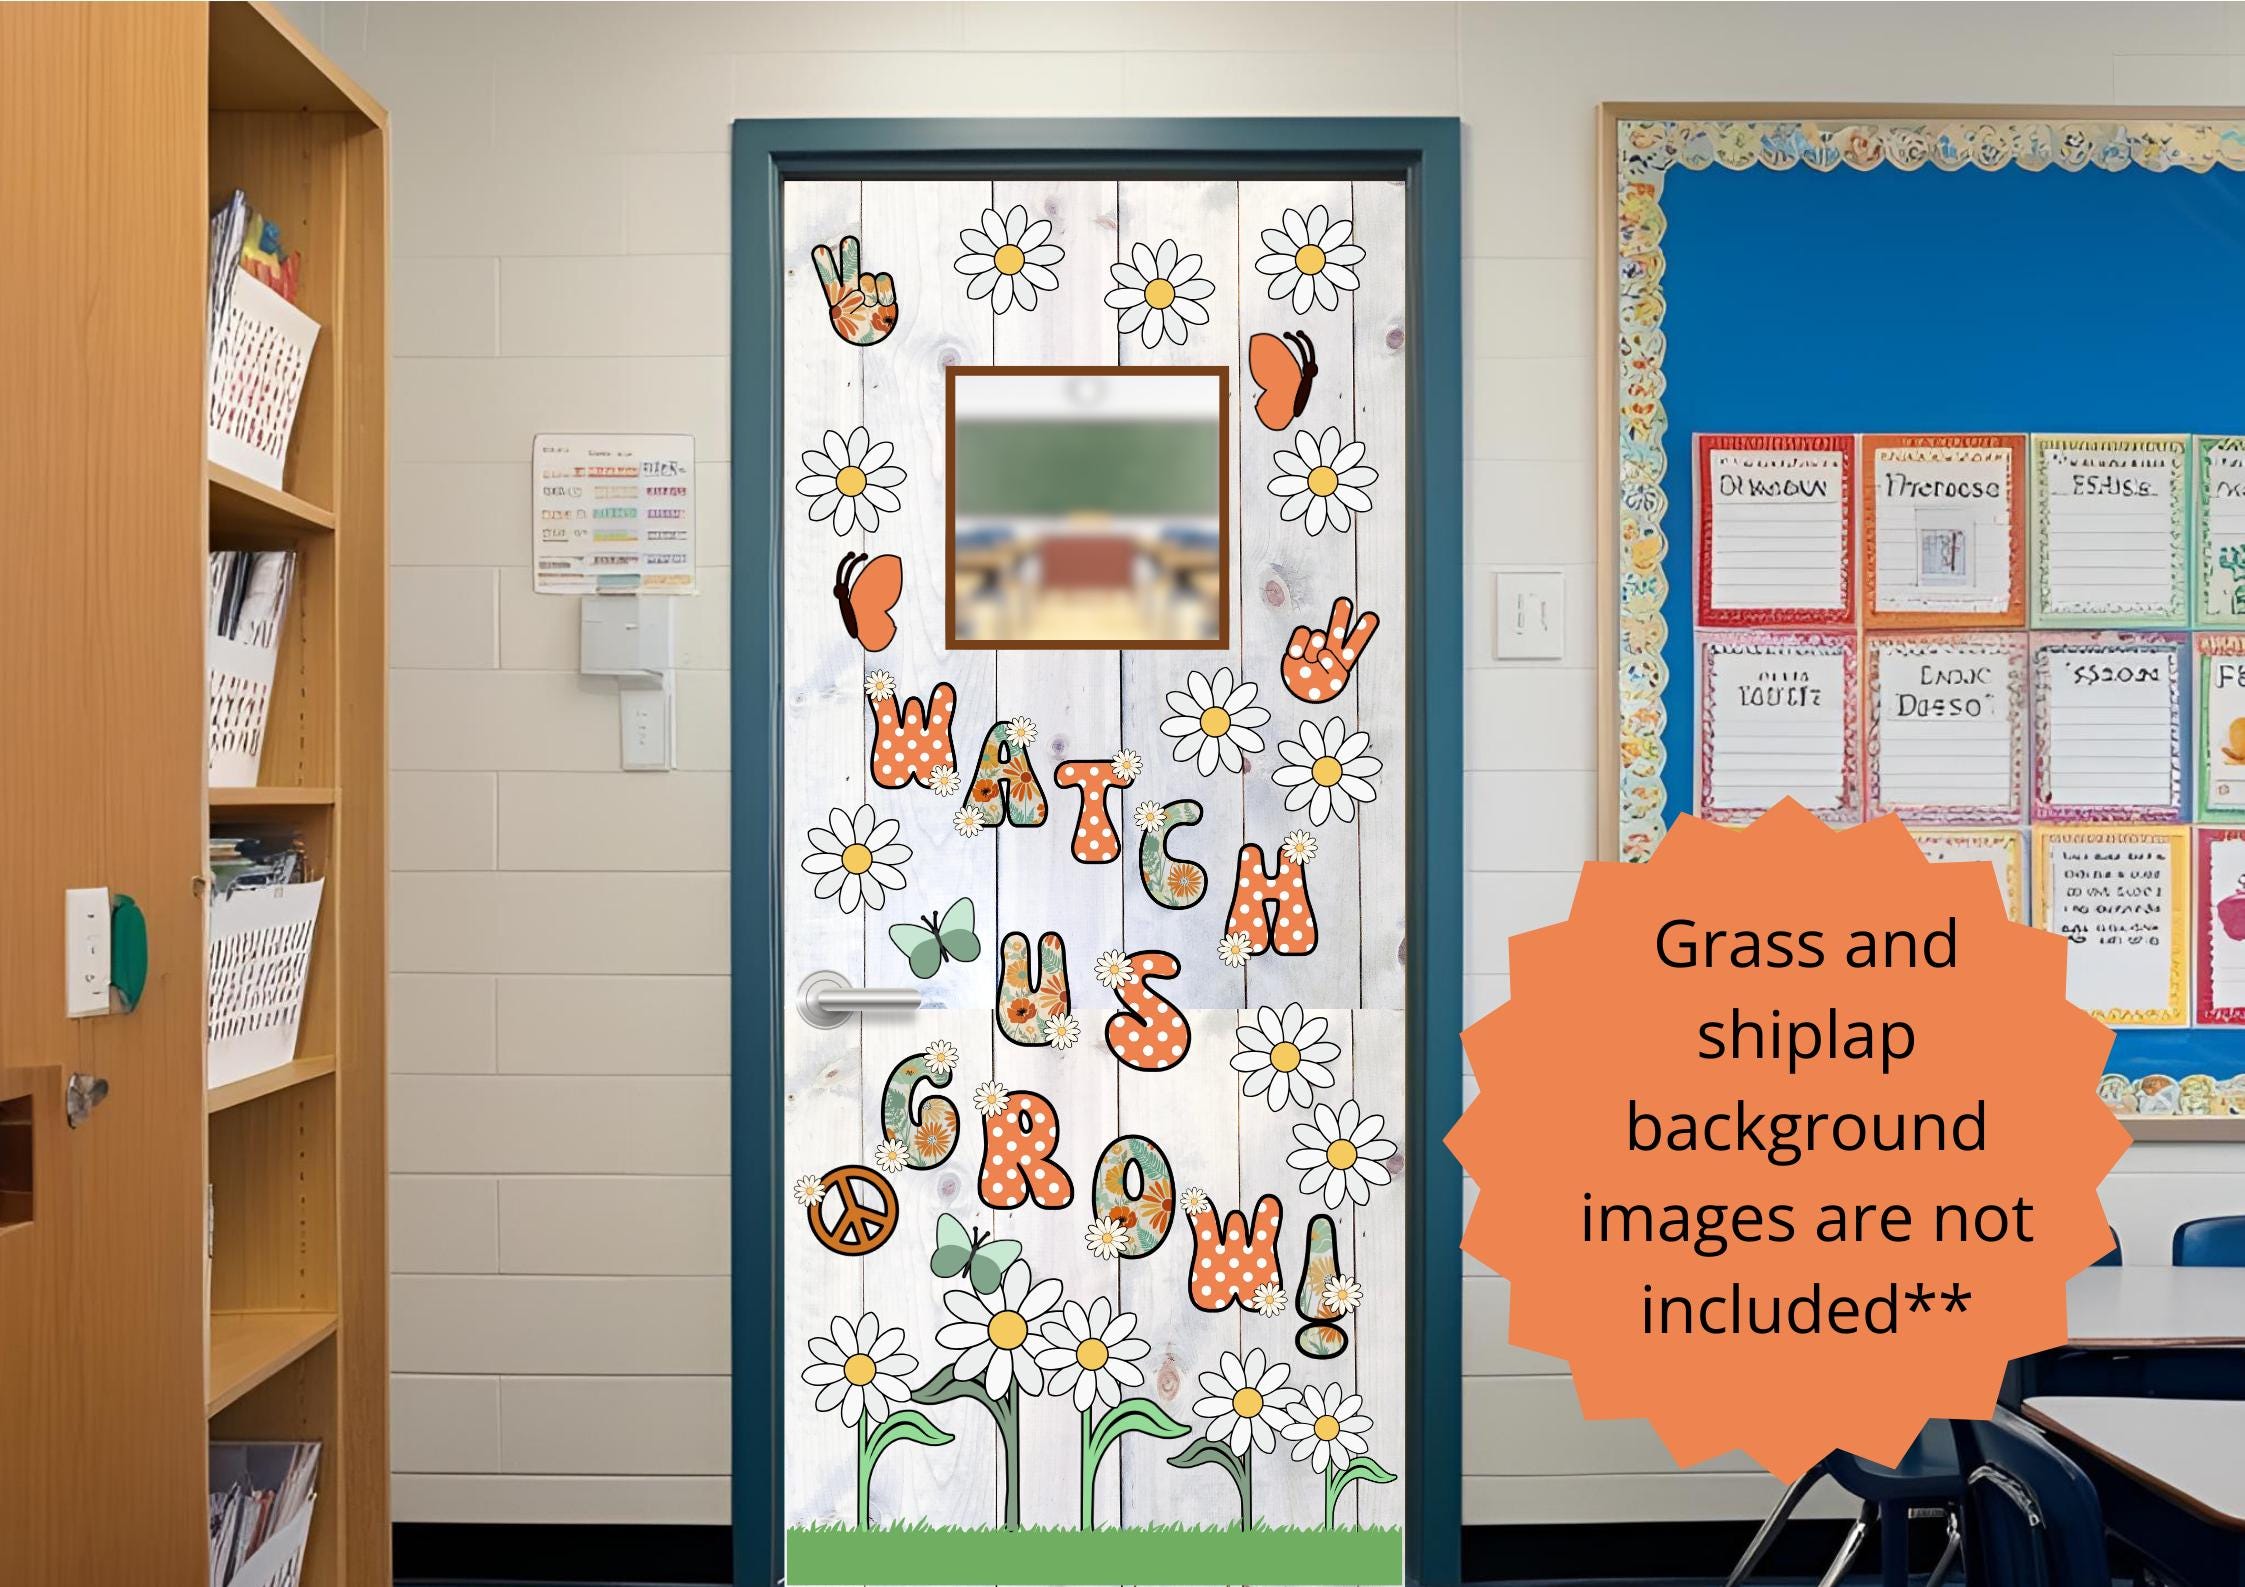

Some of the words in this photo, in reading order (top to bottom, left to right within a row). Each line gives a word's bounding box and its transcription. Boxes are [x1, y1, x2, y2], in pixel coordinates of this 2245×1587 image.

[868, 682, 1318, 956] WATCH
[995, 931, 1192, 1071] US
[882, 1053, 1349, 1360] GROW!
